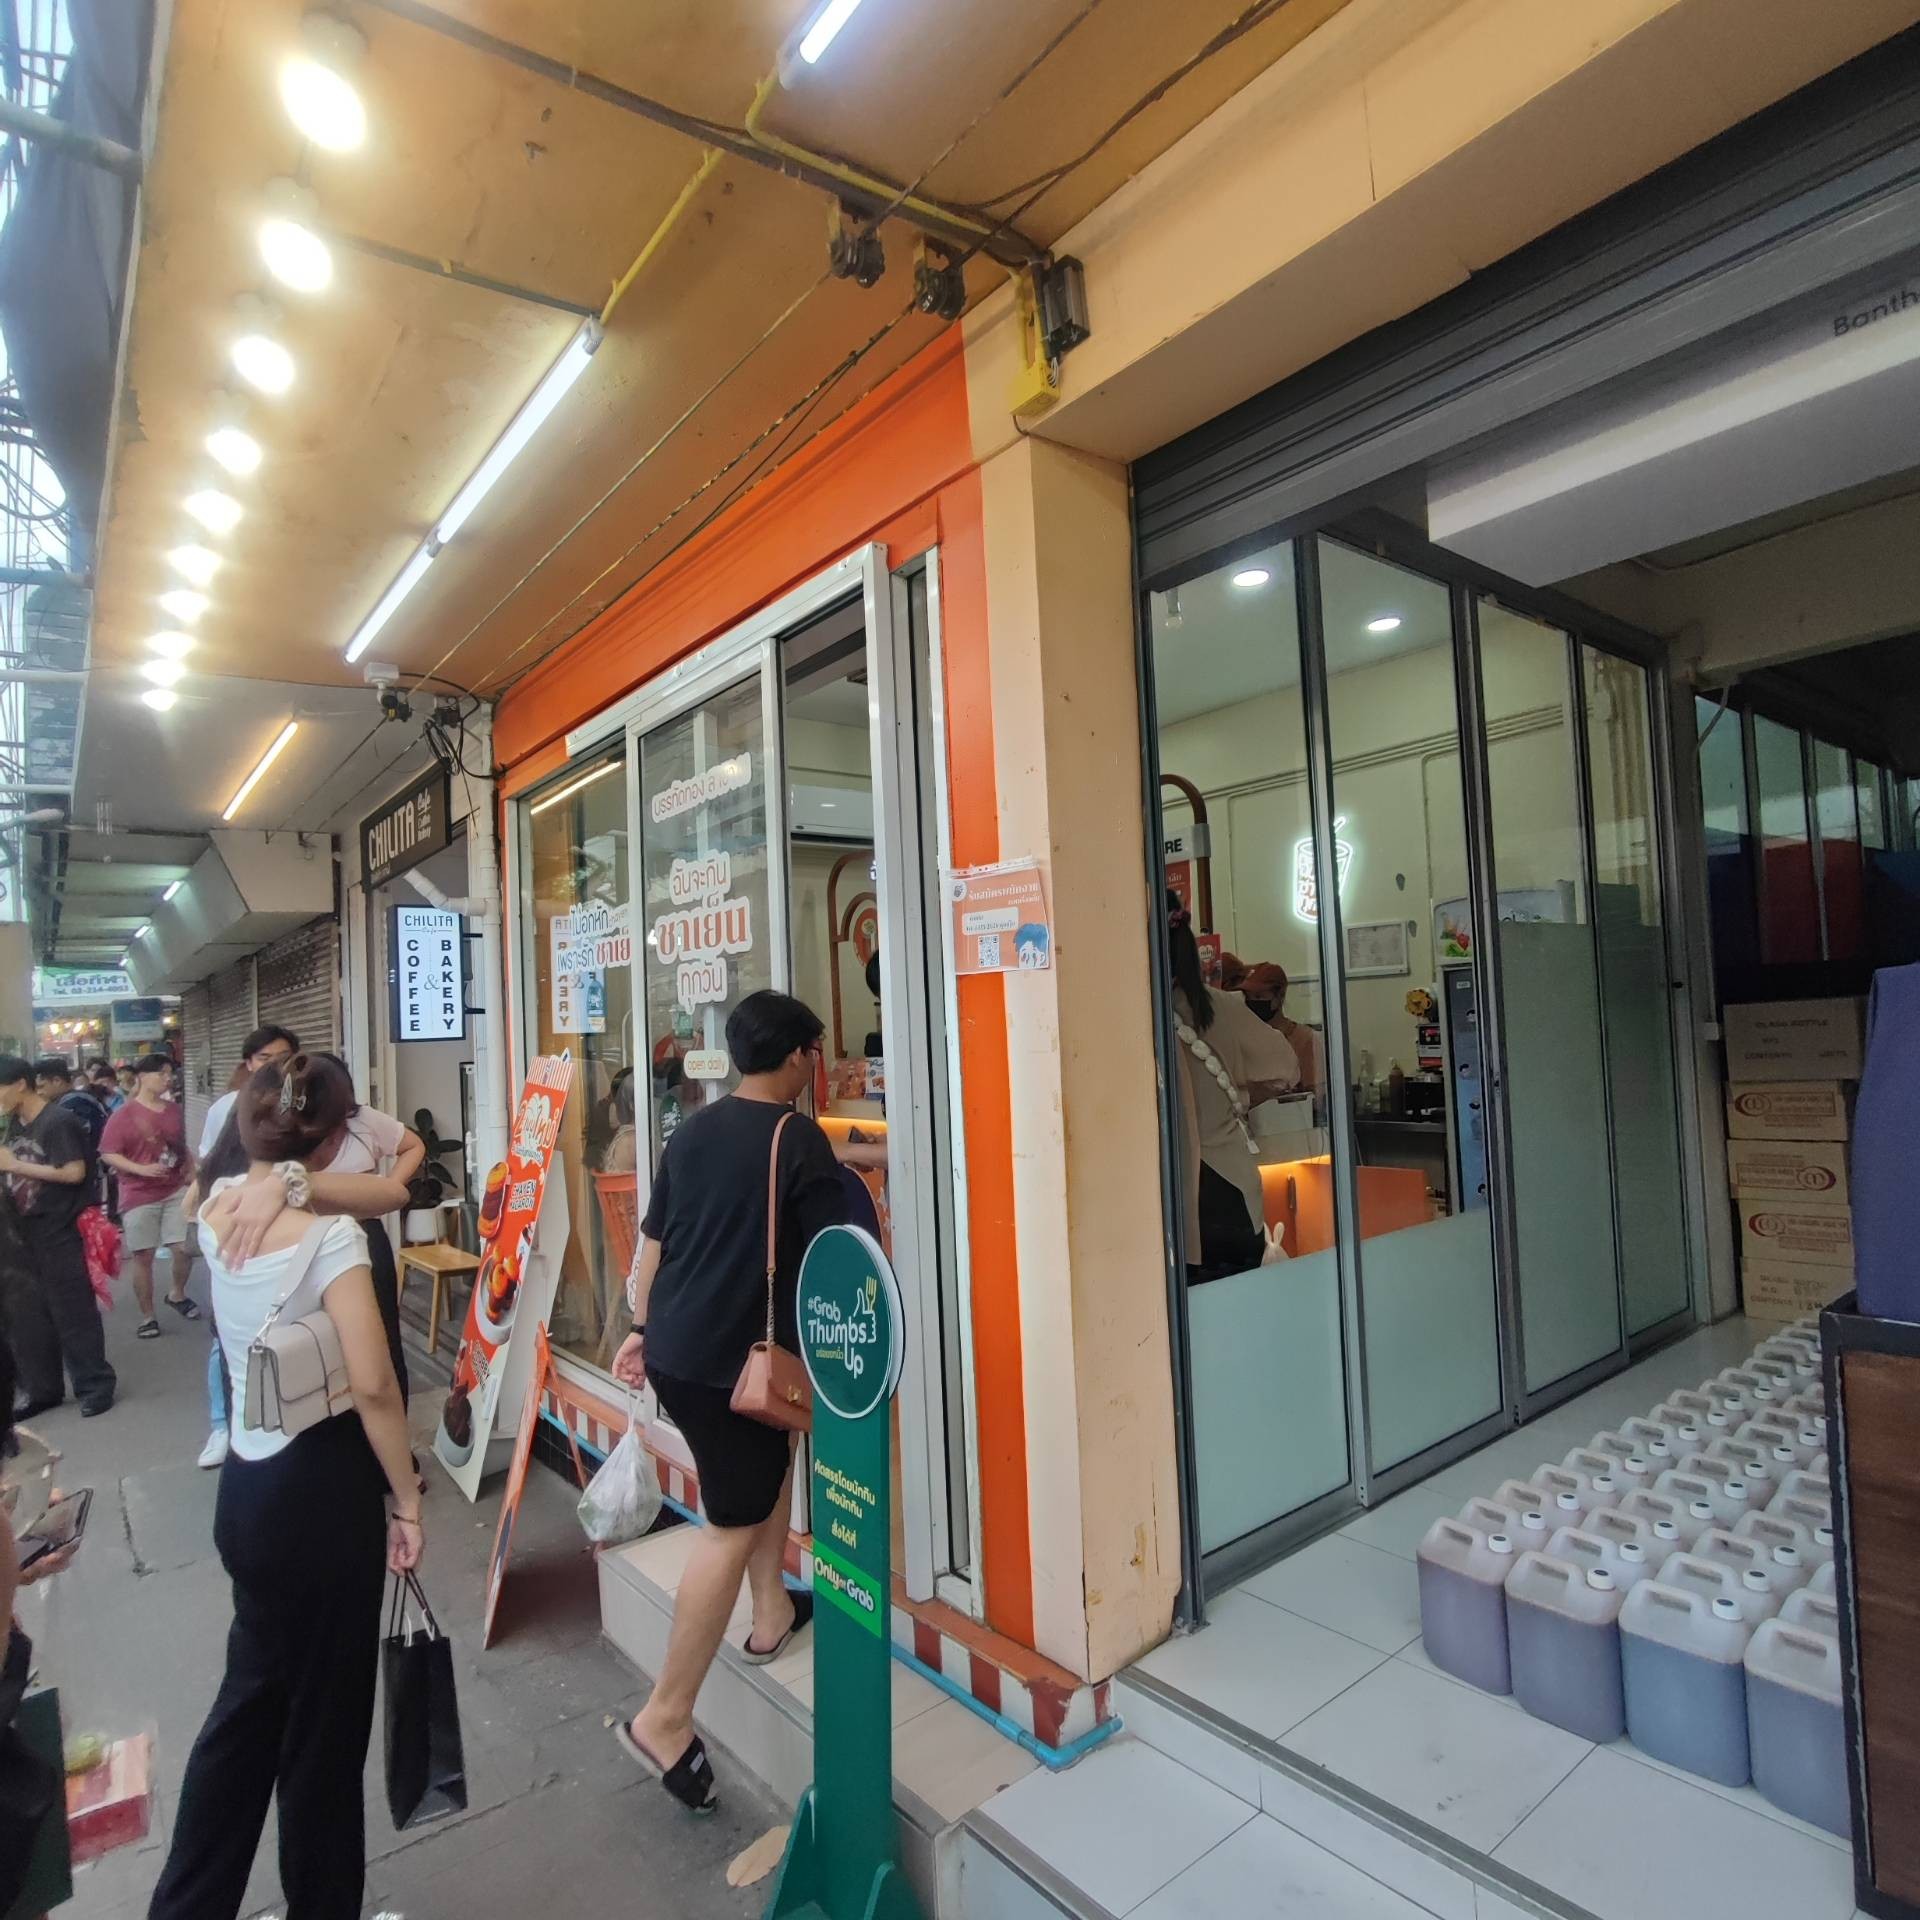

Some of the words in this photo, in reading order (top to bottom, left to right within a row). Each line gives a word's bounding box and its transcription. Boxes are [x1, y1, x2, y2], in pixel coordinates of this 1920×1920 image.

[369, 800, 415, 872] CHILITA
[672, 859, 727, 897] ฉันจะกิน
[404, 915, 453, 927] CHILITA
[658, 892, 747, 956] ชาเย็น
[407, 940, 420, 1032] COFFEE
[424, 973, 440, 990] &
[441, 940, 454, 1030] BAKERY
[681, 962, 723, 1004] ทุกวัน
[807, 1295, 841, 1323] #Grab
[807, 1315, 867, 1344] Thumbs
[814, 1556, 840, 1591] Only
[846, 1578, 874, 1612] Grab
